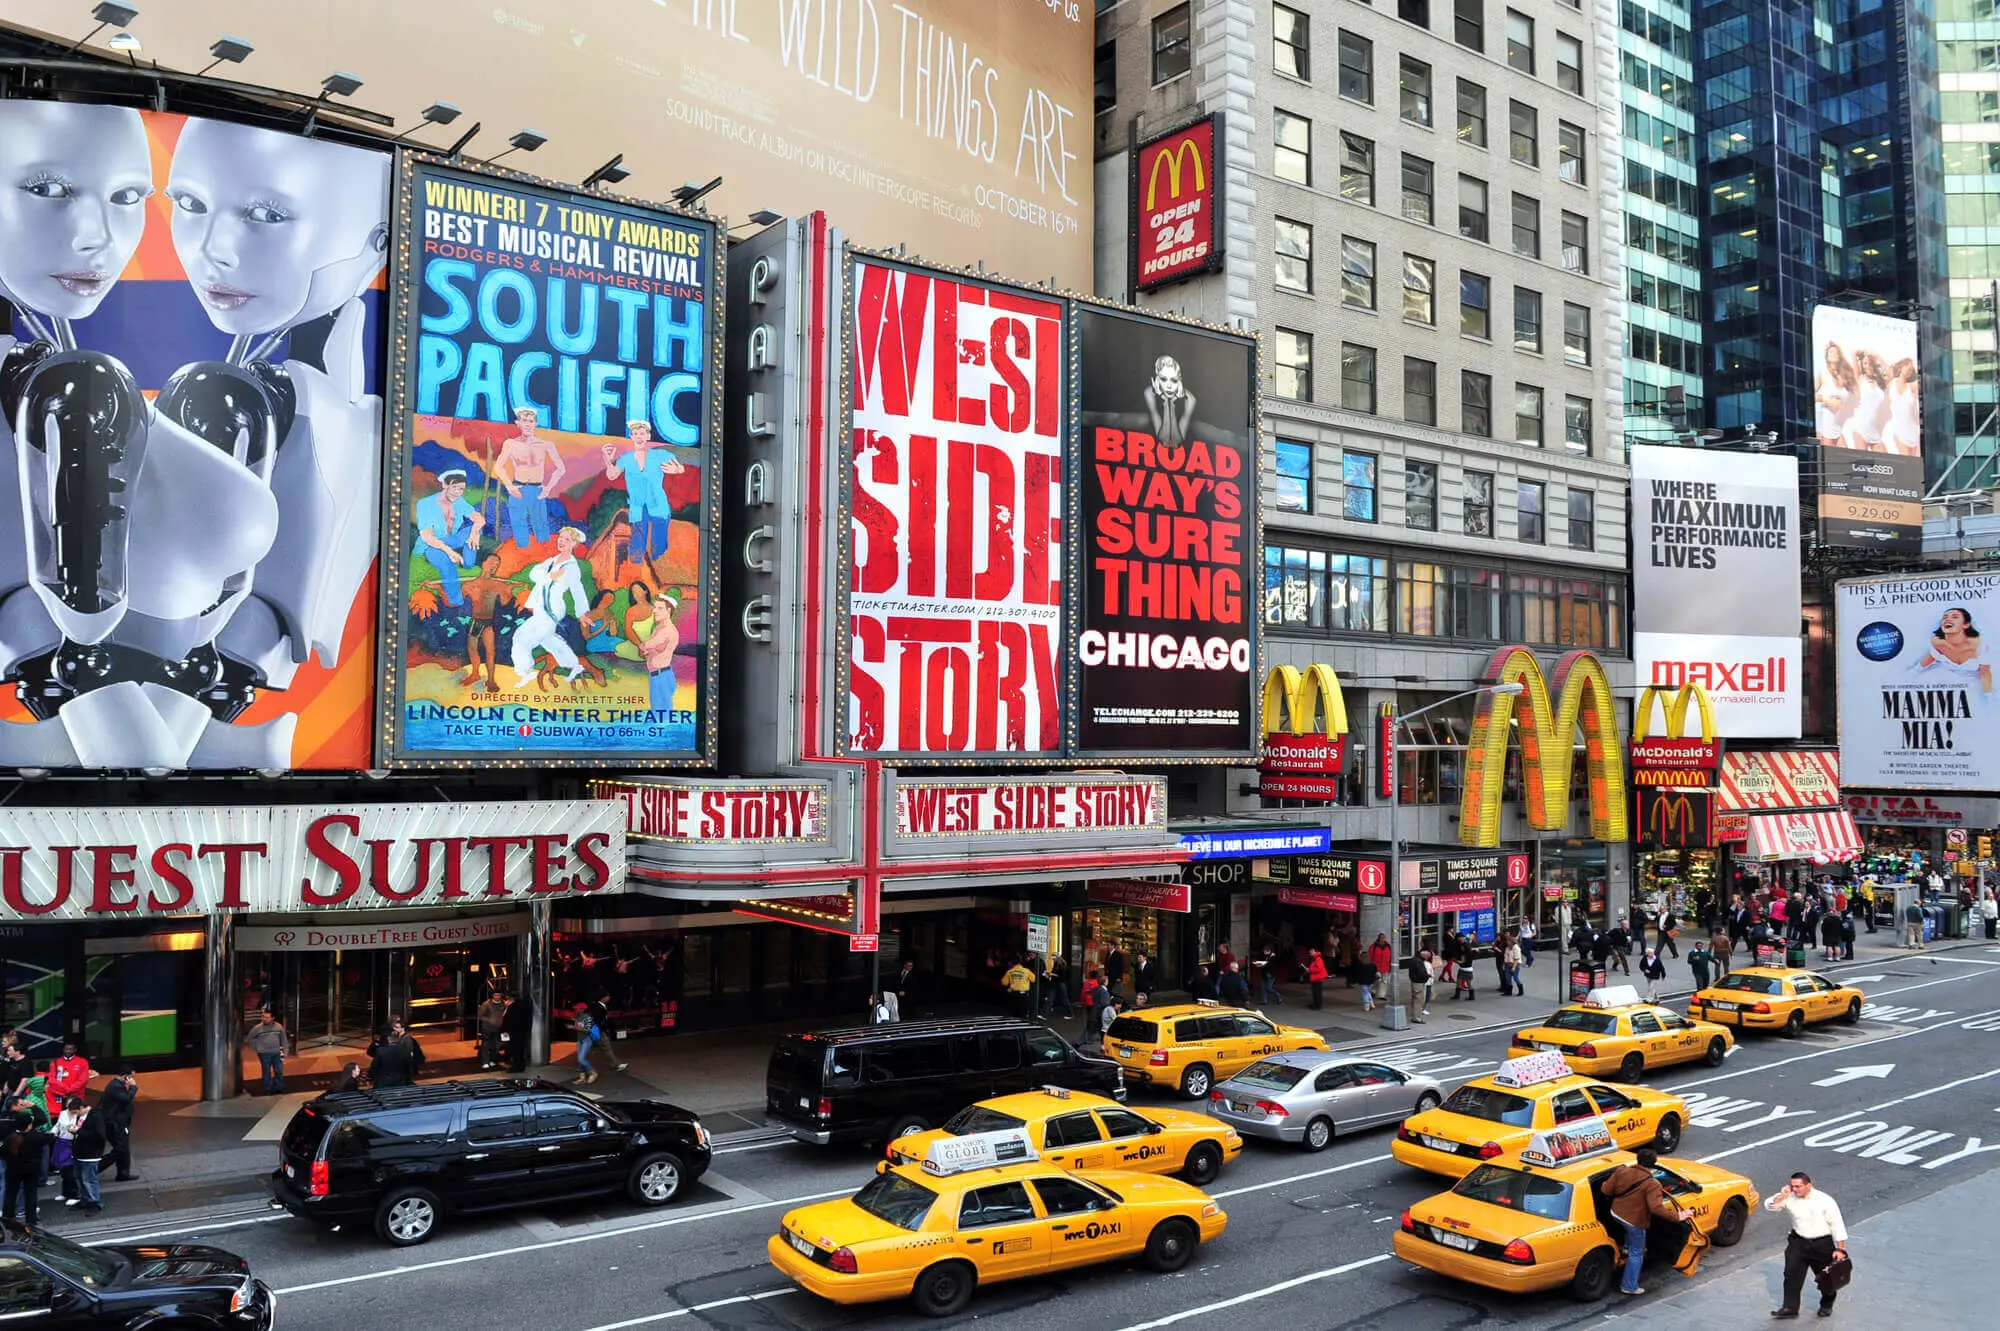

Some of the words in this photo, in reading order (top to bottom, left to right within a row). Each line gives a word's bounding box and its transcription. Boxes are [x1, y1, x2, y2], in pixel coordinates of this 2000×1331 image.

[778, 0, 880, 102] WILD
[892, 3, 998, 163] THINGS
[1014, 87, 1078, 206] ARE
[666, 98, 756, 146] SOUNDTRACK
[759, 134, 803, 168] ALBUM
[807, 150, 824, 175] ON
[425, 180, 526, 224] WINNER!
[535, 202, 550, 228] 7
[557, 207, 615, 241] TONY
[617, 224, 700, 258] AWARDS
[974, 184, 1048, 229] OCTOBER
[1050, 209, 1078, 235] 16TH
[1150, 198, 1201, 229] OPEN
[425, 209, 488, 247] BEST
[498, 223, 605, 269] MUSICAL
[613, 246, 702, 287] REVIVAL
[1156, 217, 1195, 254] 24
[425, 240, 525, 269] RODGERS
[529, 259, 543, 273] &
[549, 262, 704, 302] HAMMERSTEIN'S
[1144, 241, 1208, 276] HOURS
[421, 258, 704, 374] SOUTH
[416, 333, 701, 447] PACIFIC
[742, 254, 779, 642] PALACE
[1095, 426, 1241, 478] BROAD
[1095, 463, 1242, 520] WAY'S
[1651, 479, 1717, 500] WHERE
[850, 427, 1062, 606] SIDE
[1651, 498, 1787, 530] MAXIMUM
[1848, 505, 1900, 521] 9.29.09
[1096, 508, 1241, 566] SURE
[1651, 525, 1787, 549] PERFORMANCE
[1651, 544, 1717, 569] LIVES
[1095, 557, 1241, 624] THING
[1880, 579, 1950, 594] FEEL-GOOD
[1954, 575, 2000, 589] MUSIC
[853, 599, 976, 615] TICKETMASTER.COM
[1864, 596, 1875, 606] IS
[1878, 595, 1889, 605] A
[1079, 629, 1250, 673] CHICAGO
[849, 615, 1061, 752] STORY
[1652, 656, 1786, 692] maxell
[471, 692, 528, 704] DIRECTED
[533, 694, 548, 704] BY
[553, 694, 613, 704] BARTLETT
[616, 695, 645, 705] SHER
[1881, 690, 1972, 719] MAMMA
[408, 704, 504, 721] LINCOLN
[512, 706, 600, 724] CENTER
[607, 708, 693, 725] THEATER
[444, 724, 486, 736] TAKE
[489, 725, 516, 736] THE
[533, 725, 593, 738] SUBWAY
[597, 726, 615, 737] TO
[618, 726, 645, 738] 66TH
[647, 726, 664, 738] ST
[1901, 720, 1954, 750] MIA!
[1262, 745, 1338, 759] McDonald's
[1270, 759, 1324, 768] Restaurant
[1632, 747, 1714, 758] McDonald's
[1645, 758, 1699, 766] Restaurant
[1260, 783, 1285, 791] OPEN
[1300, 785, 1331, 794] HOURS
[640, 788, 689, 838] SIDE
[700, 790, 809, 839] STORY
[907, 787, 988, 833] WEST
[993, 785, 1068, 830] SIDE
[1075, 783, 1153, 828] STORY
[1881, 809, 1964, 820] COMPUTERS
[1212, 840, 1223, 852] IN
[1224, 840, 1242, 851] OUR
[1243, 838, 1292, 851] INCREDIBLE
[1292, 836, 1323, 848] PLANET
[301, 813, 611, 906] SUITES
[1297, 856, 1320, 867] TIMES
[1321, 858, 1352, 870] SQUARE
[1446, 859, 1470, 870] TIMES
[1470, 857, 1499, 868] SQUARE
[1298, 866, 1350, 879] INFORMATION
[1309, 876, 1338, 887] CENTER
[1447, 867, 1497, 880] INFORMATION
[1459, 879, 1487, 890] CENTER
[1262, 1043, 1284, 1055] TAXI
[943, 1142, 961, 1150] MAN
[945, 1145, 988, 1160] GLOBE
[1123, 1152, 1139, 1161] NYC
[1139, 1145, 1166, 1160] TAXI
[1803, 1120, 2000, 1169] ONLY
[1064, 1230, 1085, 1241] NYC
[1085, 1222, 1121, 1239] TAXI
